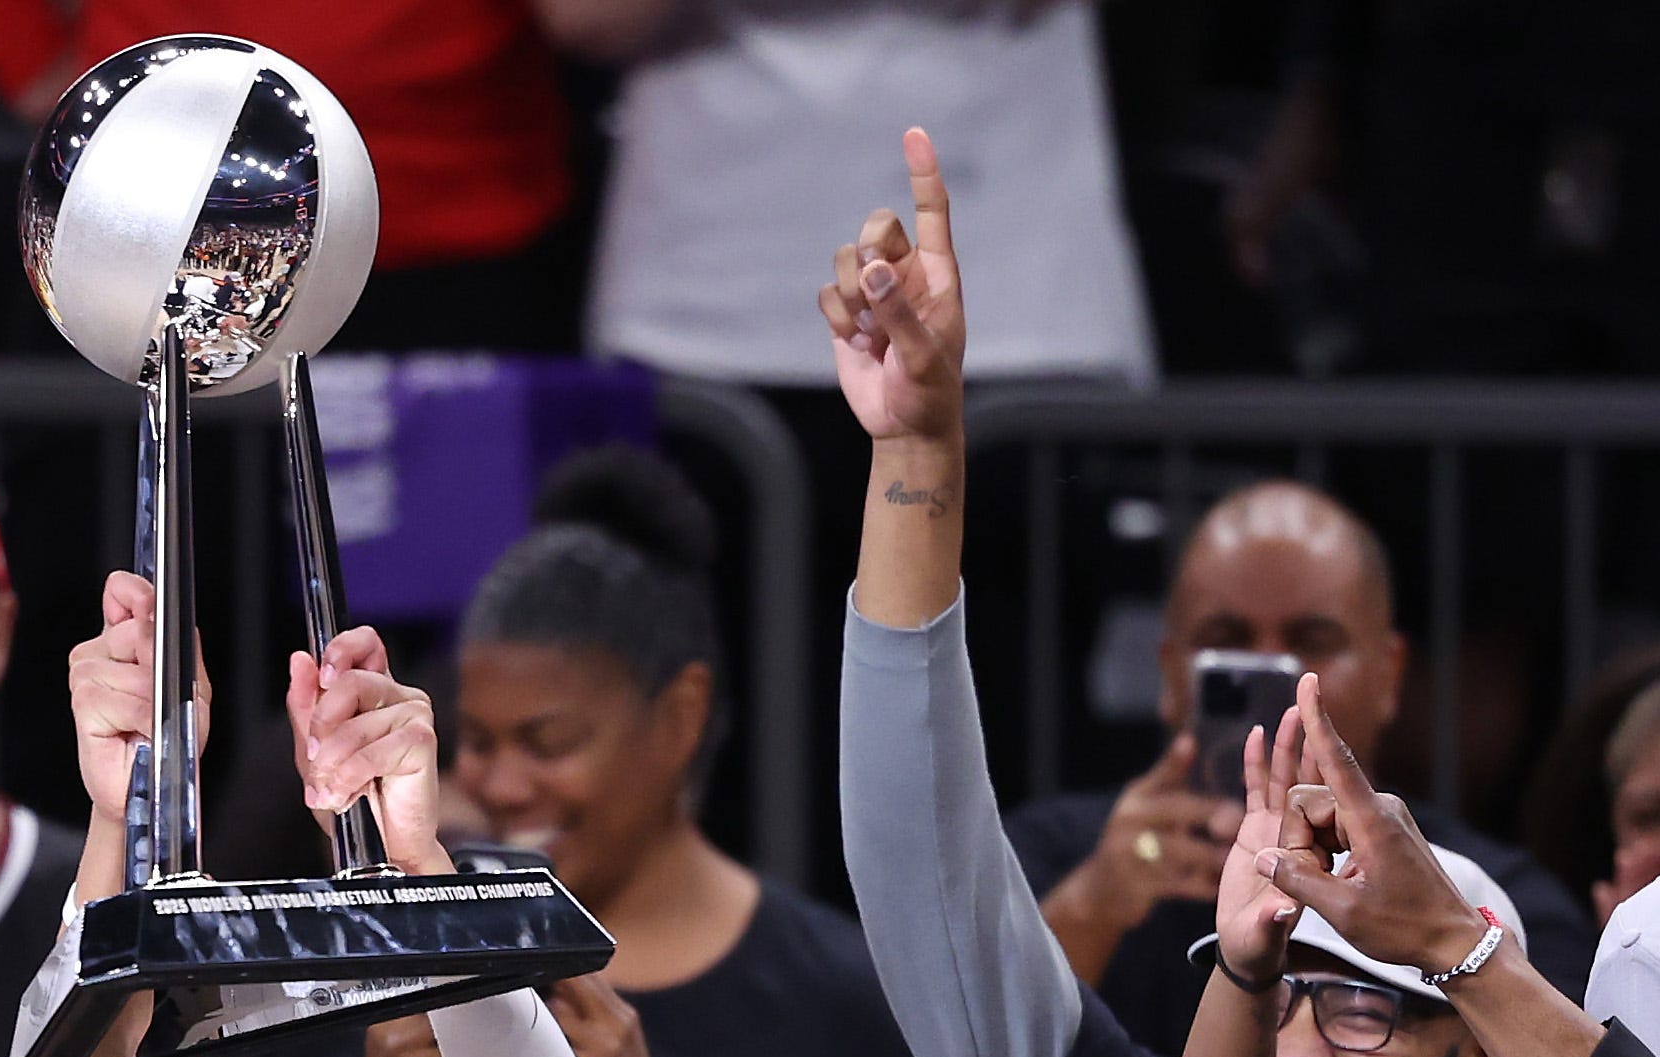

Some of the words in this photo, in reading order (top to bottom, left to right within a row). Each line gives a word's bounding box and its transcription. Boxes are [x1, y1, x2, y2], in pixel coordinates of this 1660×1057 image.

[251, 893, 317, 910] NATIONAL
[314, 888, 395, 907] BASKETBALL
[393, 885, 478, 904] ASSOCIATION
[476, 881, 555, 900] CHAMPIONS
